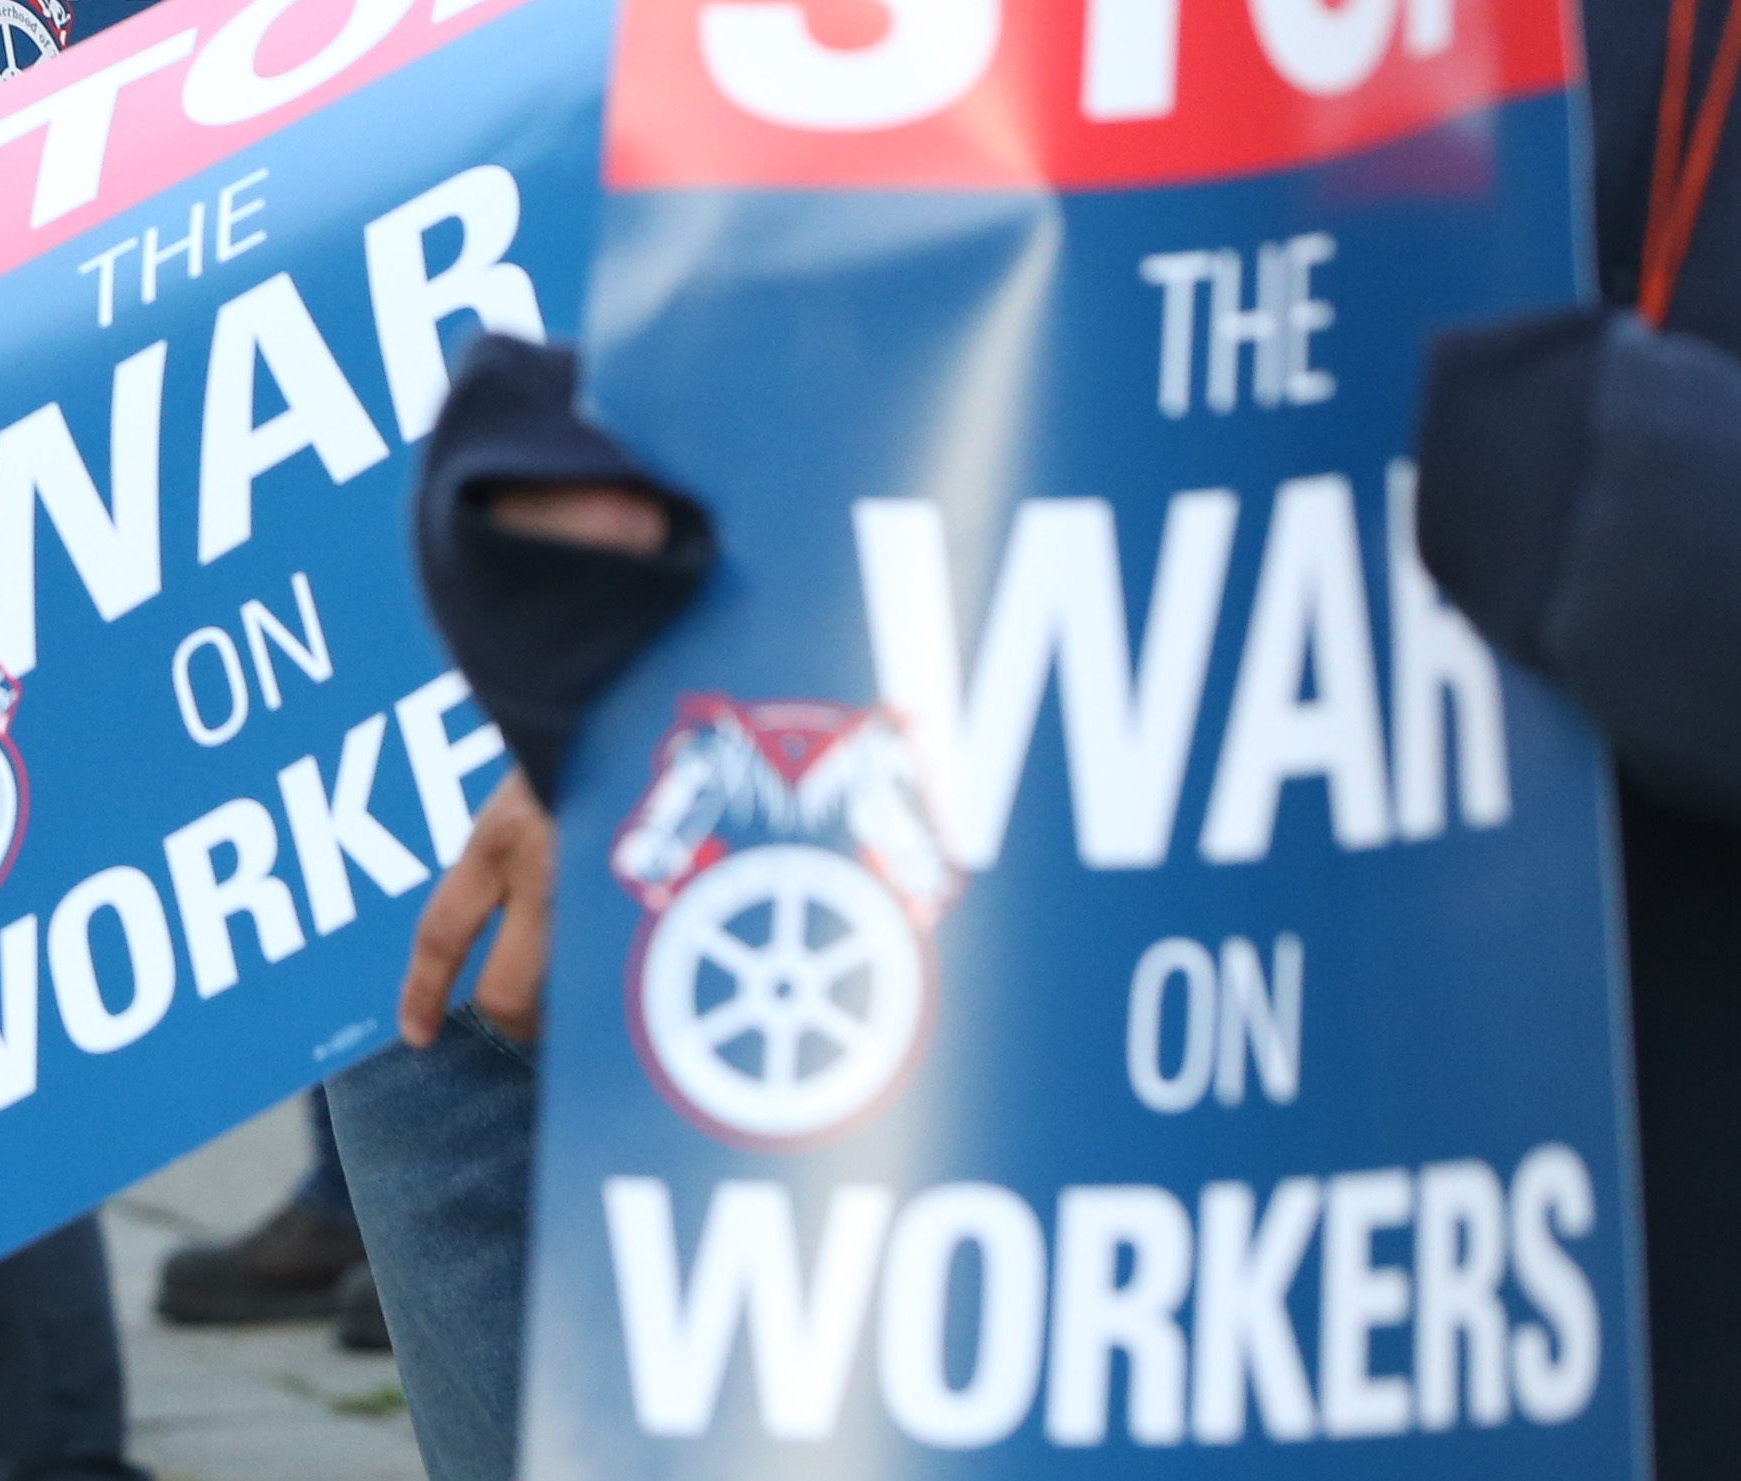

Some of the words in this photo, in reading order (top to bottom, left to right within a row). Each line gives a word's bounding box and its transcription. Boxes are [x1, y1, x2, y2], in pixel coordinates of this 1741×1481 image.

[78, 168, 269, 328] THE
[1139, 230, 1339, 418] THE
[172, 571, 334, 747] ON
[1125, 930, 1304, 1115] ON
[601, 1141, 1602, 1452] WORKERS
